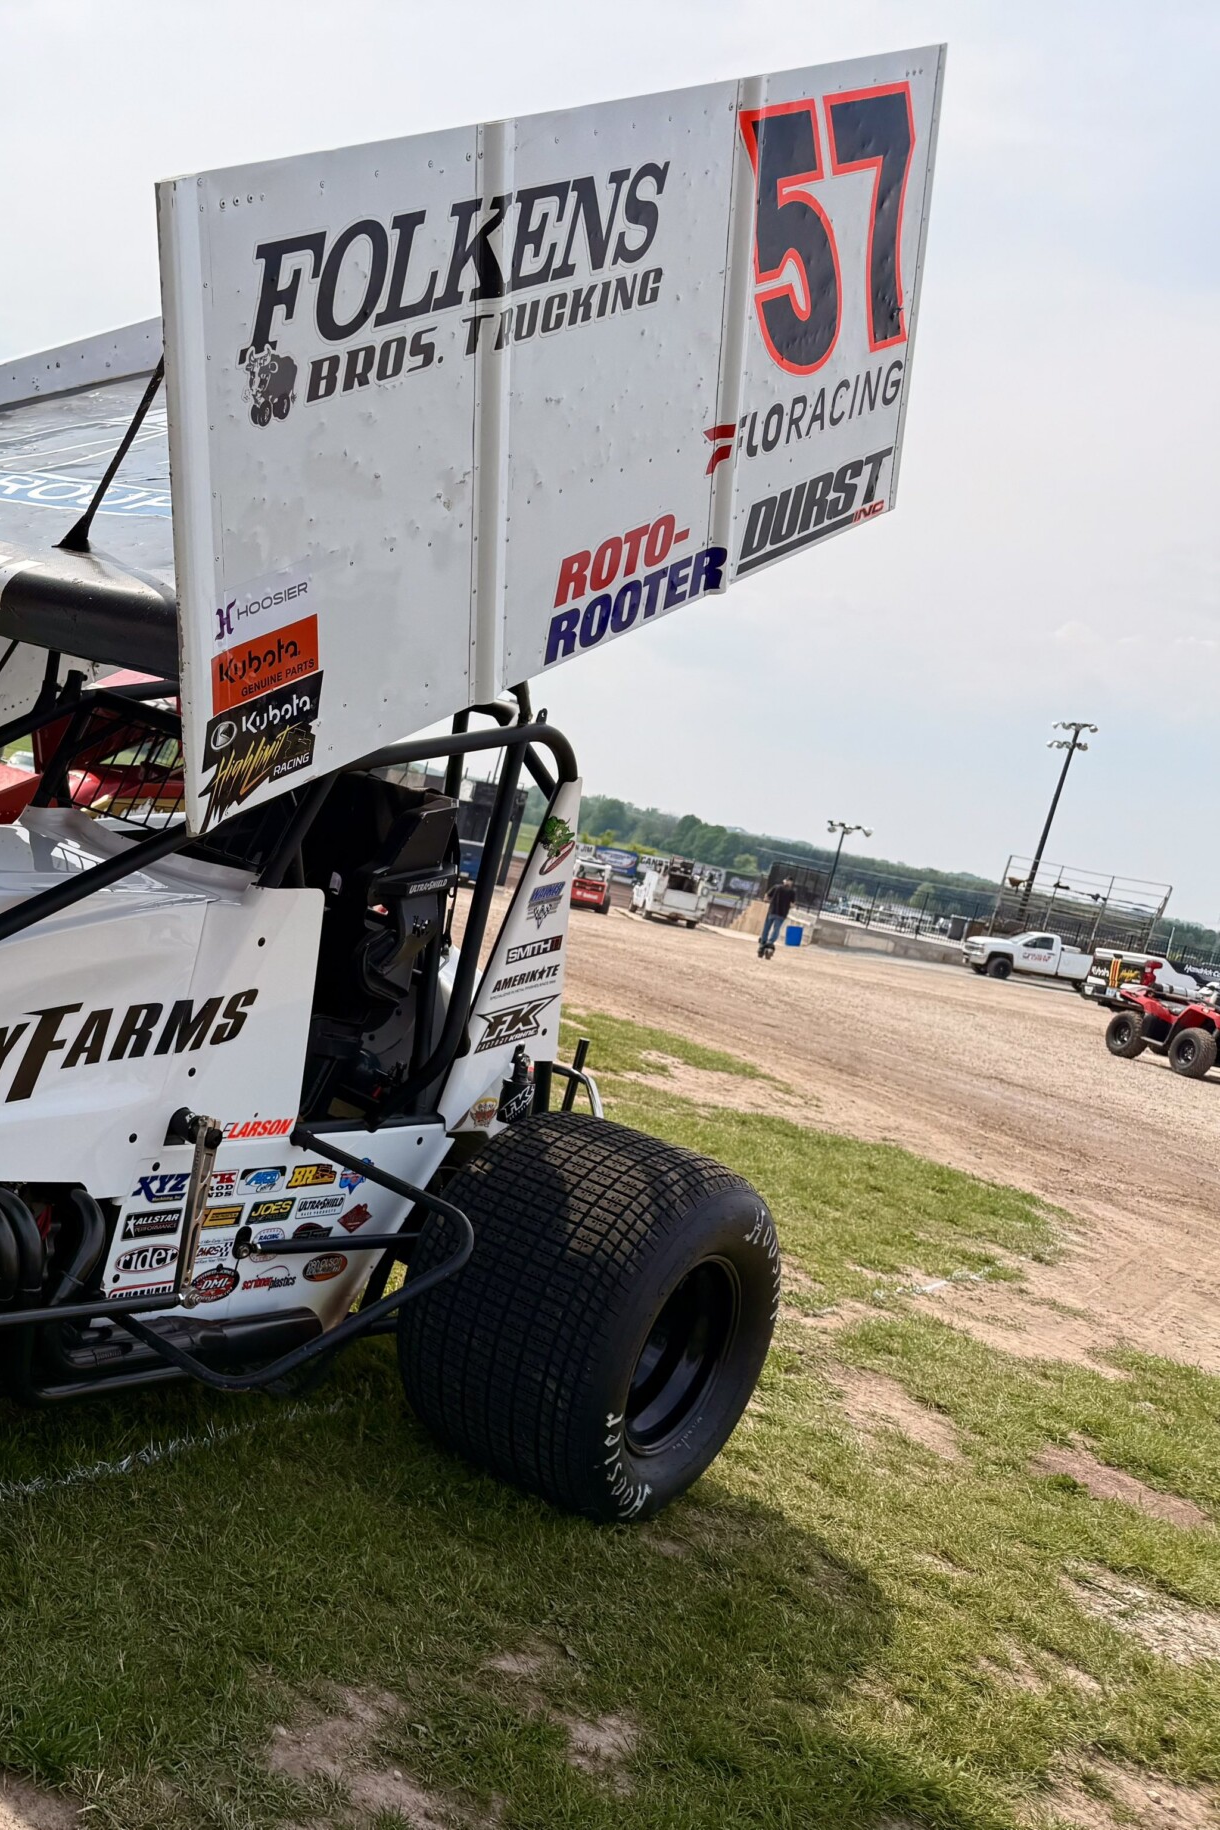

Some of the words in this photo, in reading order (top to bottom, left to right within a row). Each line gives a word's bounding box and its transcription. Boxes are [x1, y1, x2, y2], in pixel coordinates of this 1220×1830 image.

[738, 80, 916, 376] 57
[238, 161, 671, 365] FOLKENS
[305, 326, 444, 404] BROS.
[462, 267, 664, 360] TRUCKING
[739, 446, 894, 561] DURST
[853, 500, 885, 524] INC
[554, 512, 690, 609] ROTO-
[237, 581, 308, 621] HOOSIER
[543, 546, 728, 666] ROOTER
[219, 638, 300, 685] Kubota
[241, 672, 283, 698] GENUINE
[285, 658, 315, 679] PARTS
[241, 694, 313, 734] Kubota
[273, 752, 310, 777] RACING
[484, 1001, 547, 1039] FK
[227, 1118, 294, 1139] LARSON
[131, 1172, 192, 1203] XYZ
[135, 1213, 180, 1226] ALLSTAR
[251, 1200, 293, 1217] JOES
[119, 1246, 178, 1271] rider
[201, 1277, 228, 1290] DMI
